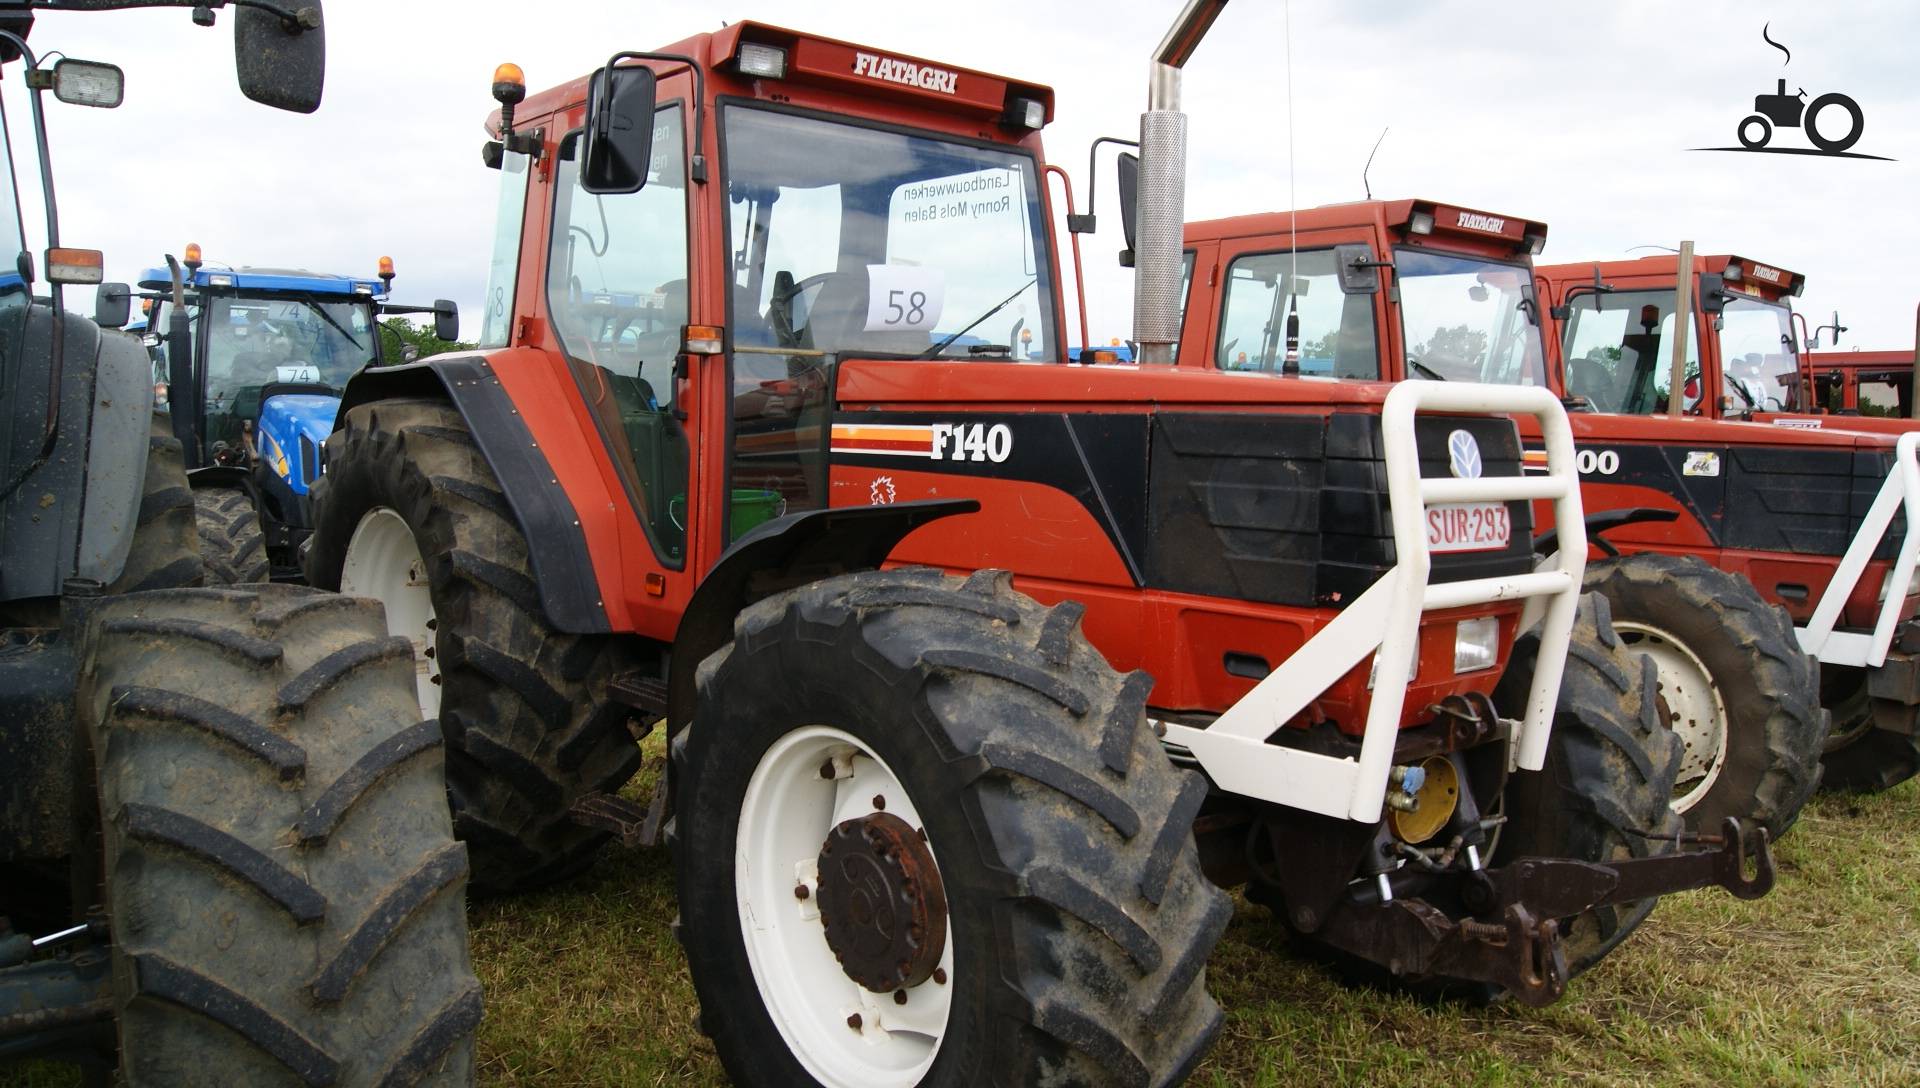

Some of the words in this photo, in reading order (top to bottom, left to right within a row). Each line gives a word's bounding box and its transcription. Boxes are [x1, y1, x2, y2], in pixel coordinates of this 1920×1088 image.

[853, 51, 958, 95] FIATAGRI
[1457, 211, 1504, 234] FIATAGRI
[884, 290, 926, 325] 58
[287, 369, 311, 383] 74
[930, 423, 1012, 463] F140
[1576, 449, 1619, 475] 00
